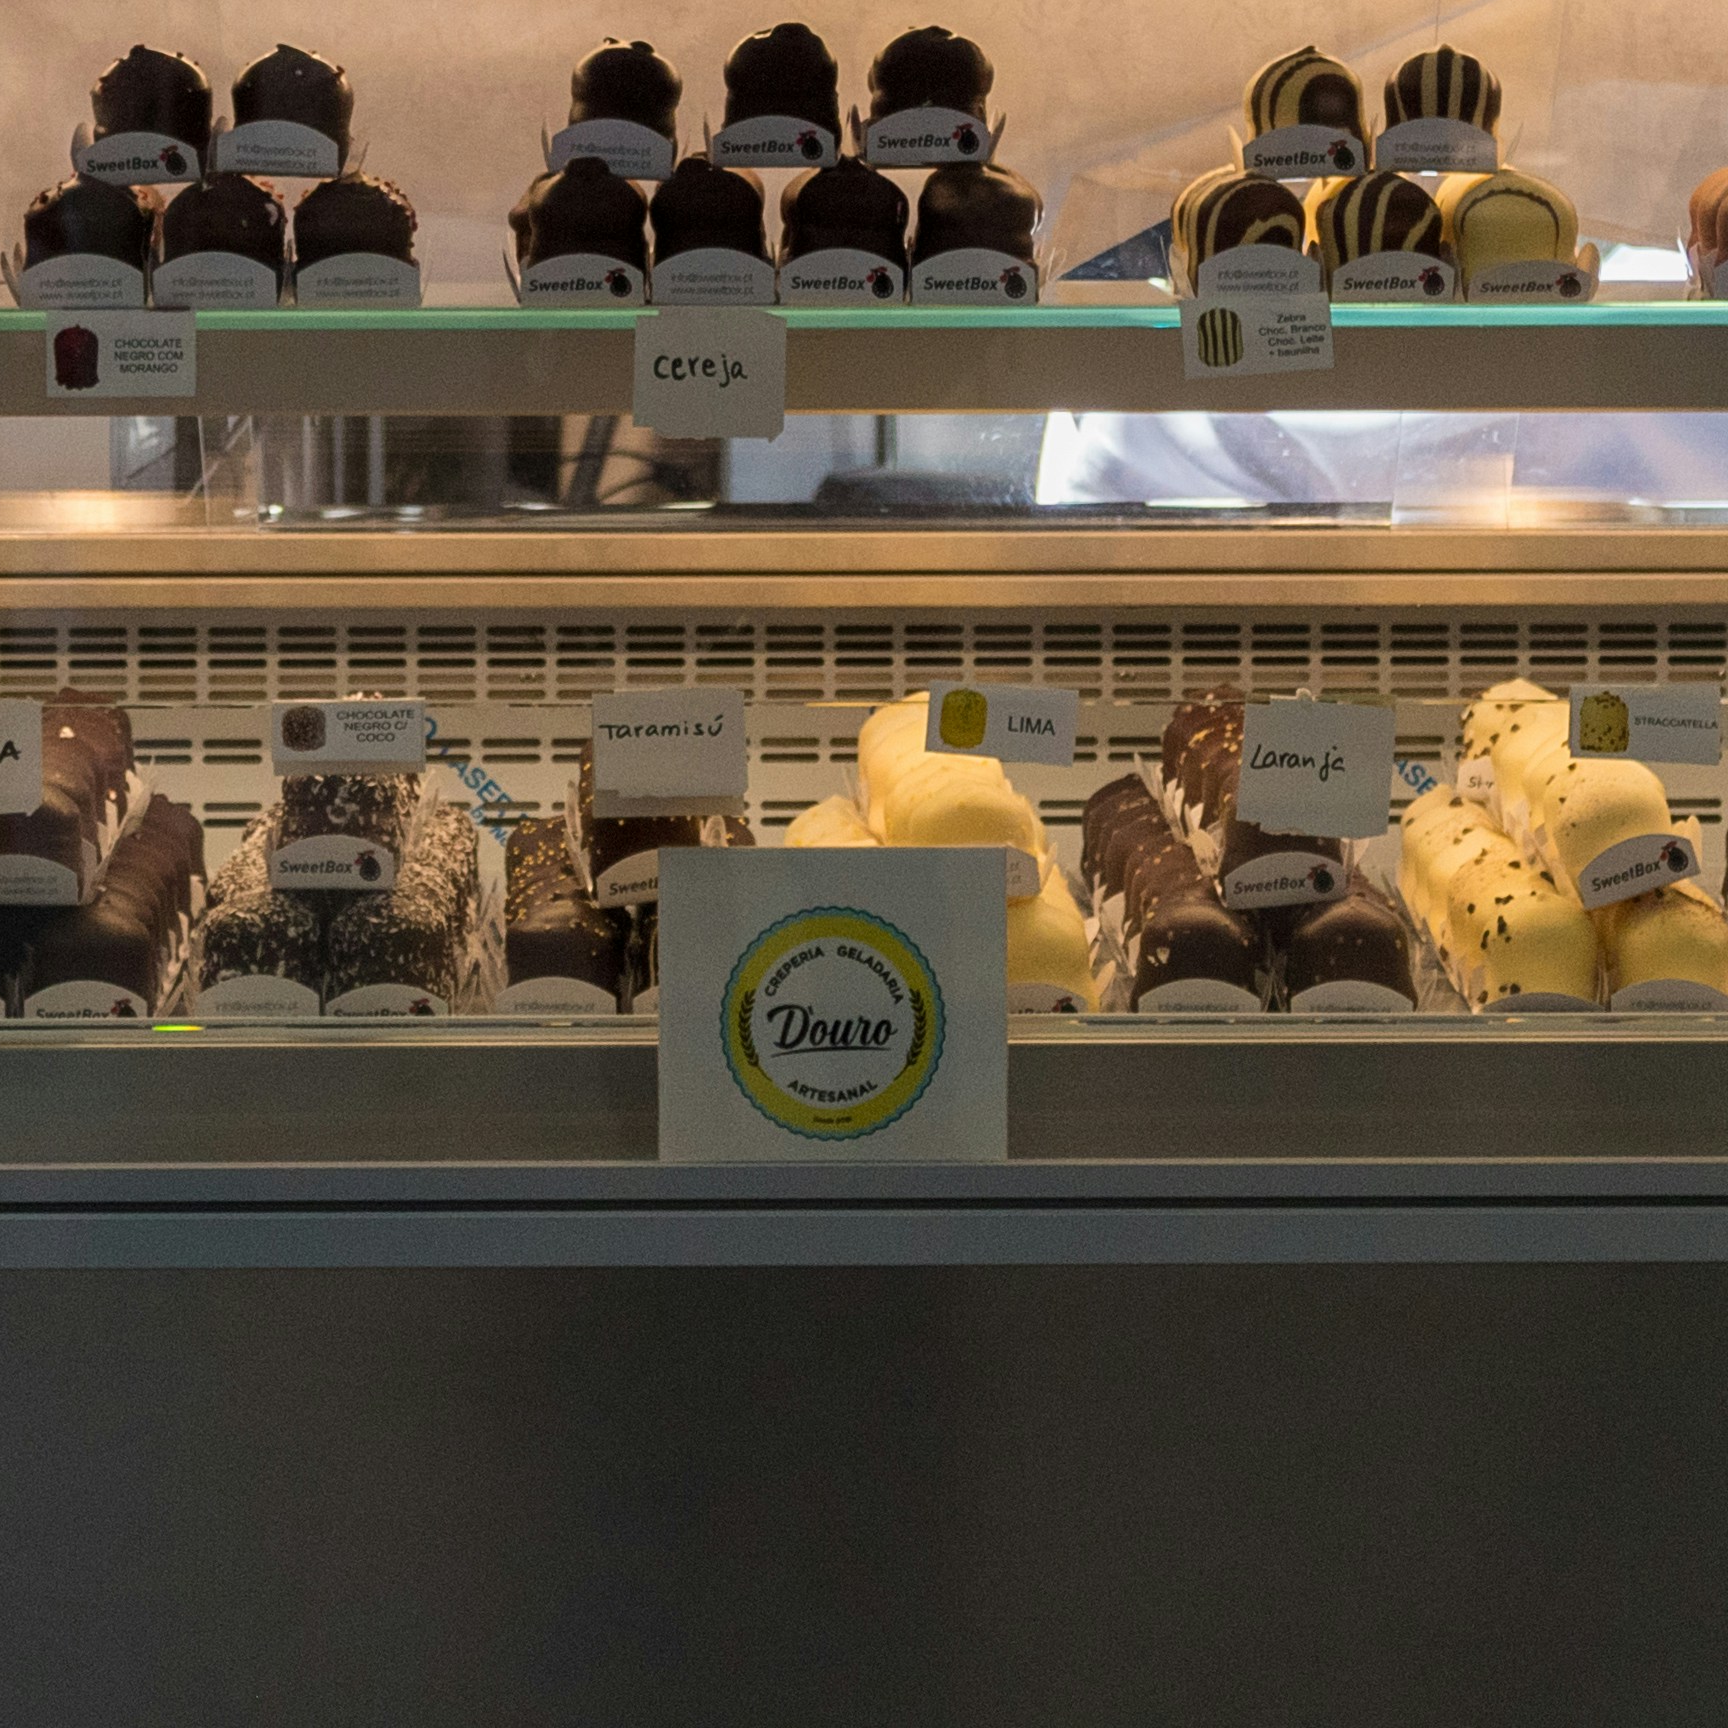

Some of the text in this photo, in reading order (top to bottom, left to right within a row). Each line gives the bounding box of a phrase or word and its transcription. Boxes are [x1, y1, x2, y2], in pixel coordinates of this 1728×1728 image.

[720, 138, 795, 156] SweetBox
[877, 134, 951, 150] SweetBox
[86, 157, 159, 173] SweetBox
[1252, 150, 1327, 168] SweetBox
[529, 276, 604, 292] SweetBox
[790, 275, 866, 291] SweetBox
[923, 275, 999, 291] SweetBox
[1343, 275, 1419, 291] SweetBox
[1480, 279, 1555, 295] SweetBox
[1275, 312, 1307, 324] Zebra
[1290, 322, 1328, 334] Branco
[114, 337, 182, 350] CHOCOLATE
[114, 350, 184, 362] NEGRO COM
[120, 362, 179, 375] MORANGO
[336, 710, 415, 721] CHOCOLATE
[1634, 716, 1718, 729] STRACCIATELLA
[343, 721, 390, 732] NEGRO
[598, 714, 724, 740] Taramisú
[1008, 716, 1055, 735] LIMA
[356, 732, 395, 742] COCO
[1250, 744, 1345, 782] Laranja
[278, 859, 352, 875] SweetBox
[1591, 857, 1662, 893] SweetBox
[608, 877, 658, 896] Sweet
[1233, 876, 1306, 895] SweetBox
[765, 944, 904, 1005] CREPERIA GELADARIA
[787, 1079, 879, 1103] ARTESANAL
